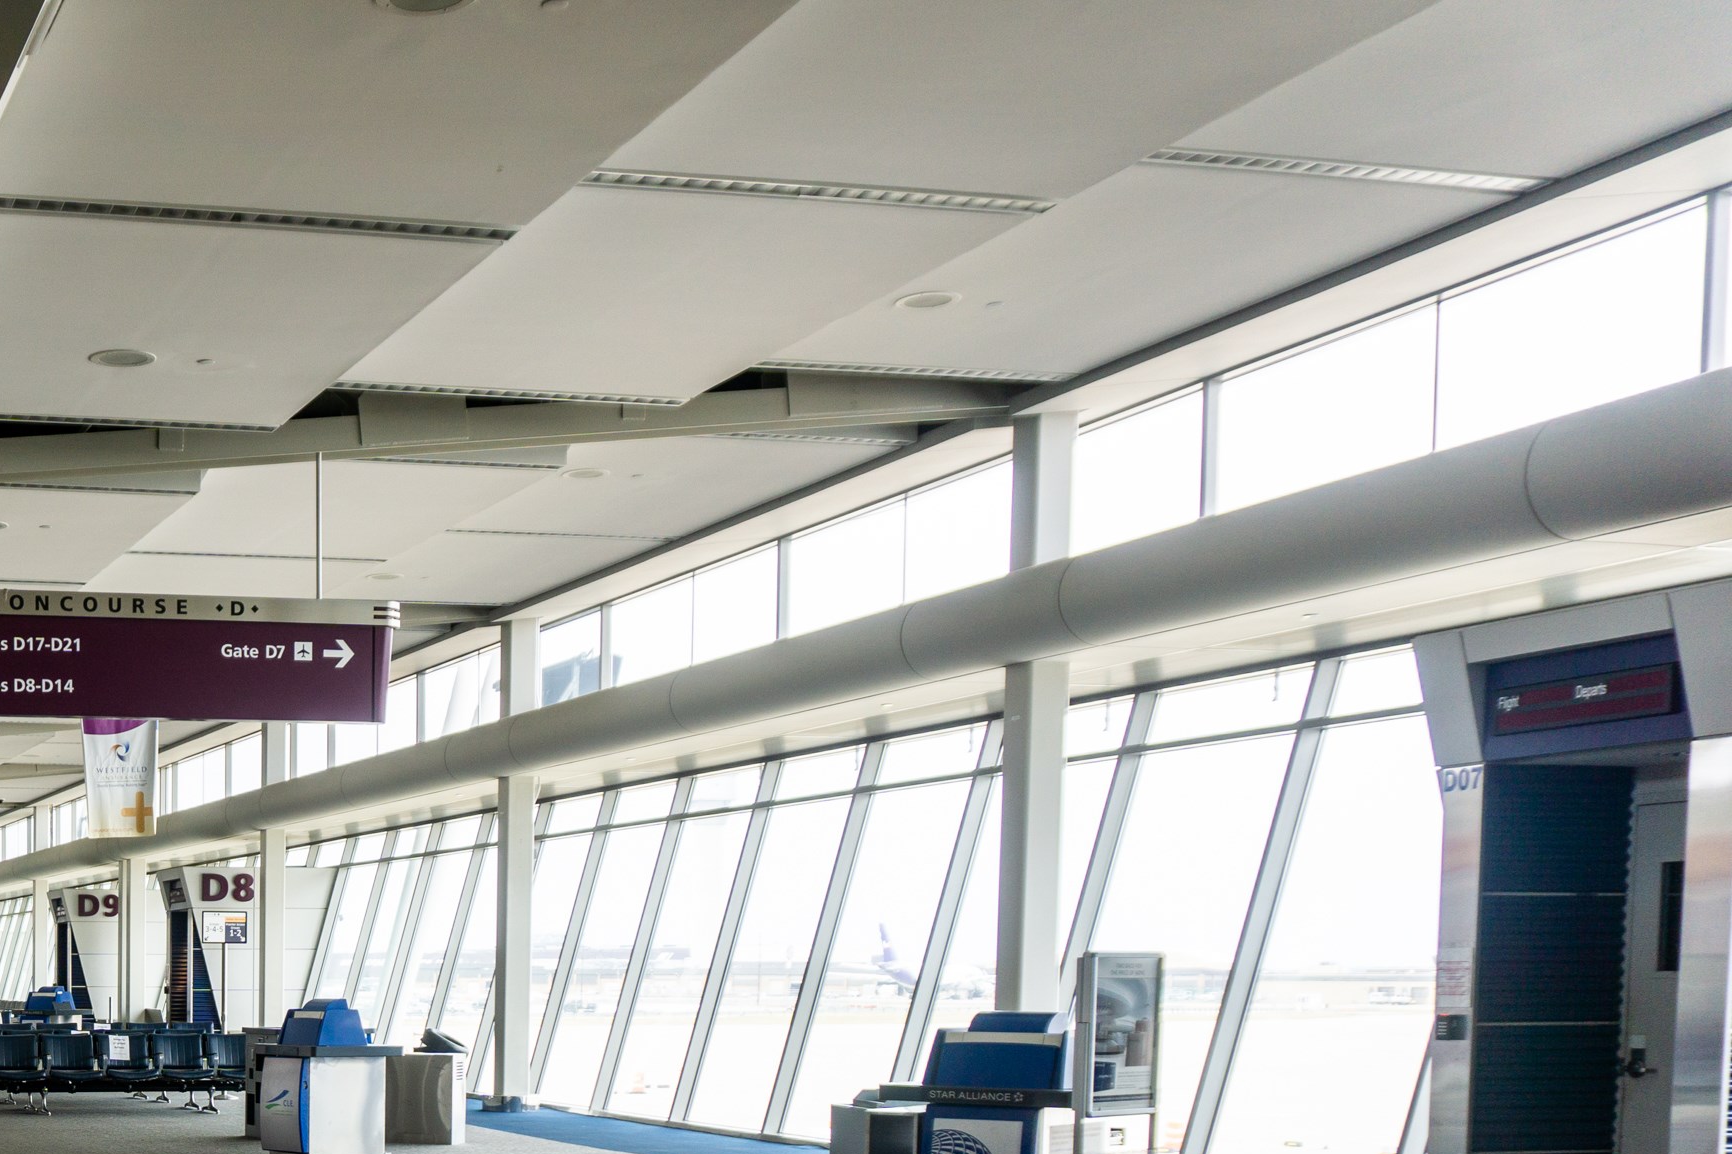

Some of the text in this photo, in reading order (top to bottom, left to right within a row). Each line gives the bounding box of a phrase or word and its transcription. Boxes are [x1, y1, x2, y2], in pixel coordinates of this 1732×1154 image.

[14, 635, 82, 653] D17-D21
[221, 643, 286, 660] Gate D7
[14, 677, 75, 694] D8-D14
[1497, 682, 1608, 712] Flight Departs
[96, 766, 148, 774] WESTFIELD
[1443, 766, 1483, 793] D07
[201, 873, 255, 902] D8
[78, 894, 119, 917] D9
[283, 1099, 294, 1108] CLE
[929, 1089, 1012, 1102] STAR ALLIANCE
